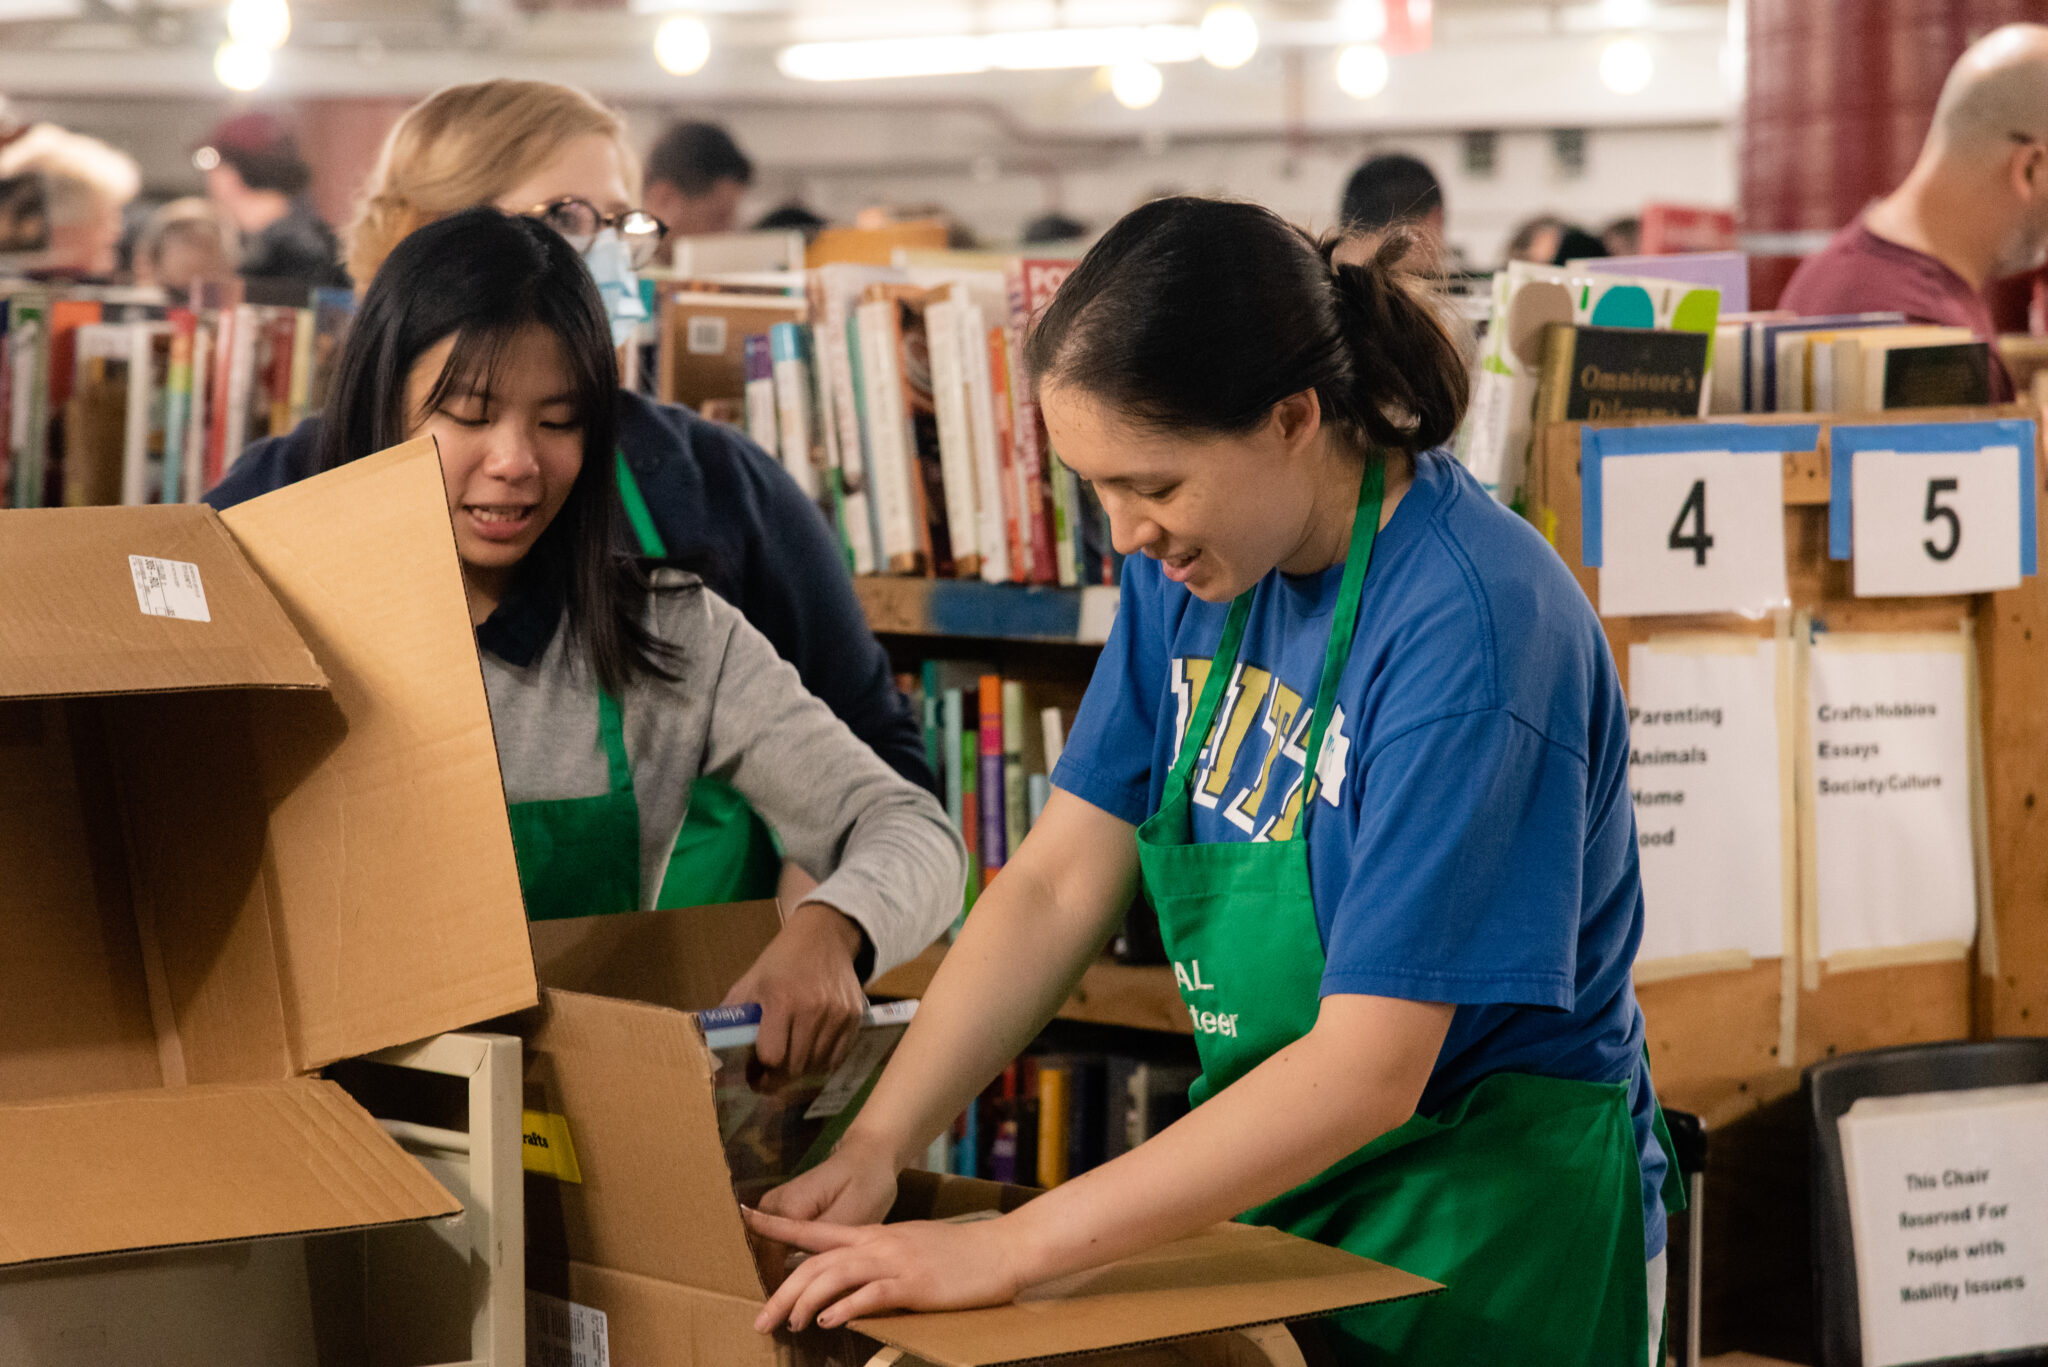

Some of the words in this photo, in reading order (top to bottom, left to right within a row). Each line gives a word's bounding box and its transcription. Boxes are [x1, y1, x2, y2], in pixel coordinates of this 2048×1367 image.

[1581, 364, 1696, 393] Omnivore's
[1668, 478, 1714, 566] 4
[1923, 478, 1961, 562] 5
[1629, 706, 1724, 728] Parenting
[1629, 745, 1708, 766] Animals
[1818, 741, 1880, 761] Essays
[1639, 827, 1676, 848] ood
[522, 1132, 549, 1149] rafts
[1905, 1172, 1937, 1192] This
[1942, 1169, 1990, 1189] Chair
[1899, 1207, 1971, 1229] Reserved
[1977, 1203, 2008, 1220] For
[1907, 1243, 1959, 1266] People
[1964, 1239, 2004, 1257] with
[1900, 1282, 1959, 1304] Mobility
[1964, 1275, 2025, 1295] Issues
